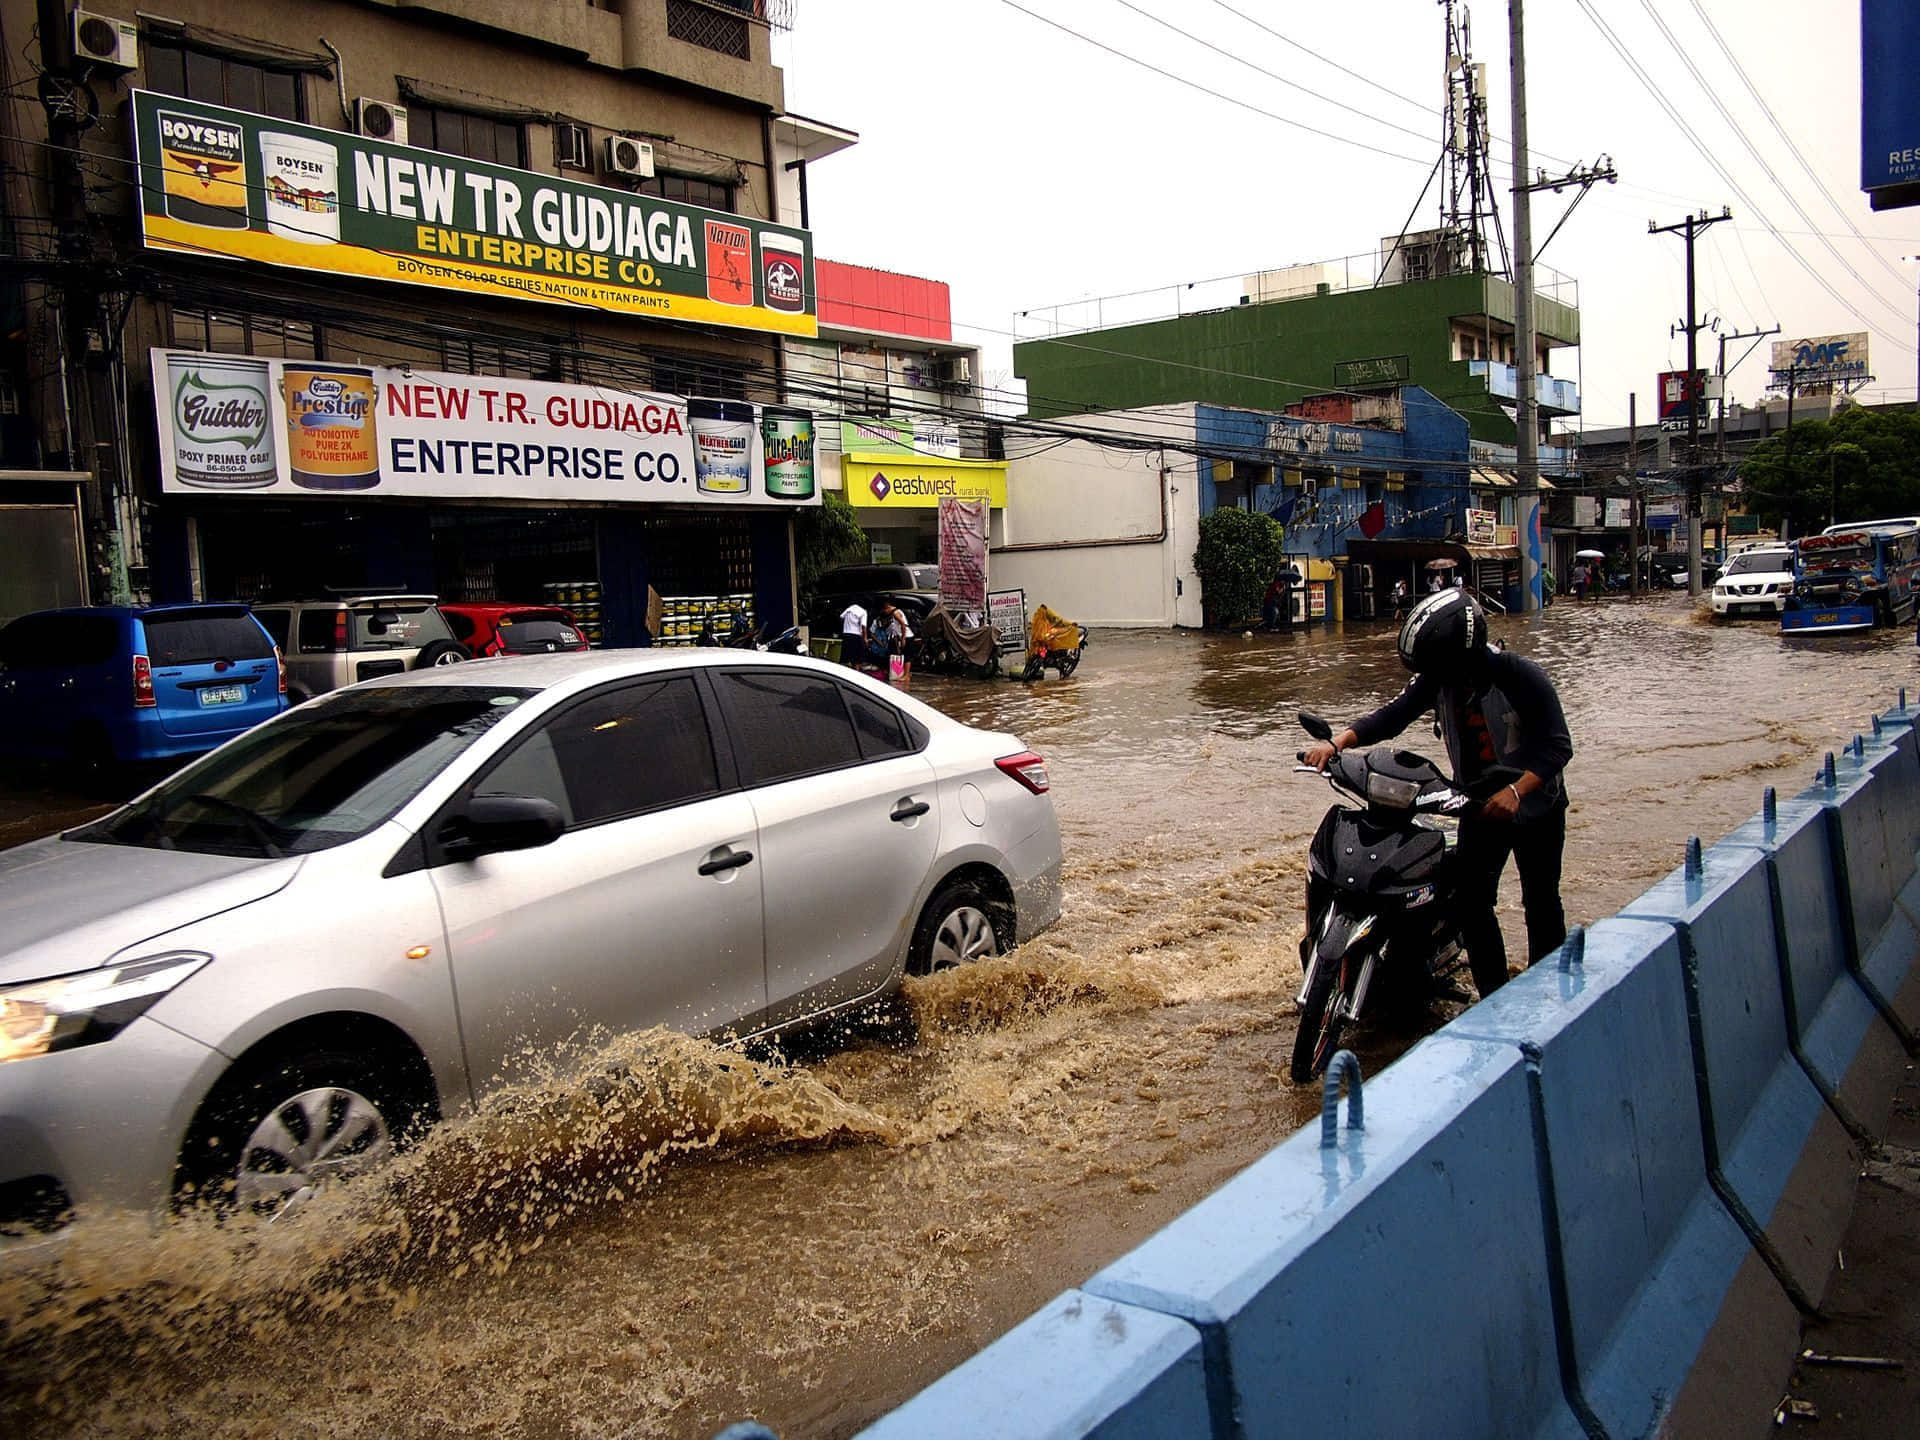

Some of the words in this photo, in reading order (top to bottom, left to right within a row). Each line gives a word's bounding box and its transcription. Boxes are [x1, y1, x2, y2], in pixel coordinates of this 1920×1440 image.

[162, 119, 240, 149] BOYSEN
[276, 156, 324, 174] BOYSEN
[354, 150, 456, 226] NEW
[465, 172, 524, 238] TR
[532, 188, 697, 269] GUDIAGA
[710, 225, 747, 249] NATION
[416, 226, 610, 280] ENTERPRISE
[618, 260, 662, 287] CO.
[455, 269, 498, 284] COLOR
[545, 282, 588, 297] NATION
[591, 289, 598, 299] &
[599, 290, 630, 304] TITAN
[632, 295, 670, 309] PAINTS
[183, 394, 264, 431] Guilder
[292, 391, 369, 420] Prestige
[386, 383, 470, 419] NEW
[478, 390, 537, 425] T.R.
[546, 395, 684, 436] GUDIAGA
[303, 427, 360, 439] AUTOMOTIVE
[1661, 419, 1706, 431] PETRN
[179, 449, 204, 463] EPOXY
[207, 453, 247, 465] PRIMER
[250, 452, 270, 464] GRAY
[300, 448, 369, 462] POLYURETHANE
[316, 440, 338, 450] PURE
[390, 438, 626, 481] ENTERPRISE
[634, 450, 688, 484] CO.
[781, 480, 799, 488] PAINTS
[893, 474, 957, 496] eastwest
[959, 487, 973, 496] rural
[975, 487, 990, 496] bank
